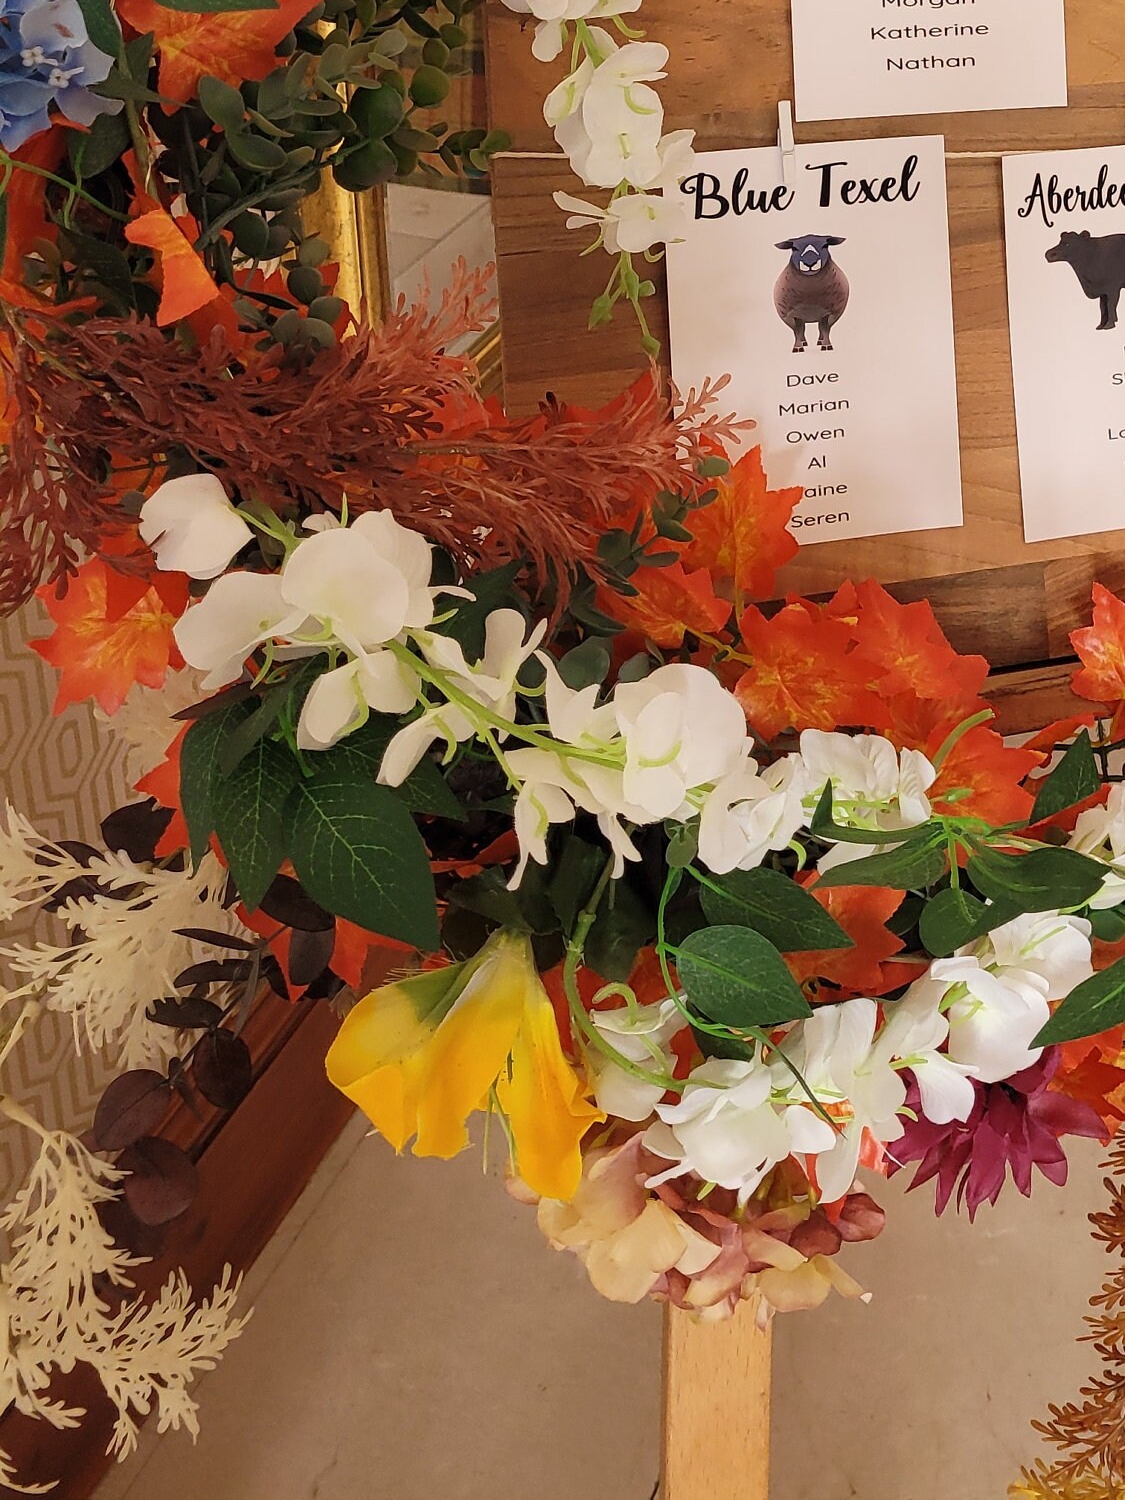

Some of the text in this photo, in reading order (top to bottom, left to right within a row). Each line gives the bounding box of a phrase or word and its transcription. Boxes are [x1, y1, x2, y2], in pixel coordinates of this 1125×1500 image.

[870, 23, 989, 40] Katherine
[886, 55, 976, 71] Nathan
[678, 154, 921, 220] Blue Texel
[786, 373, 839, 388] Dave
[779, 399, 850, 417] Marian
[786, 428, 845, 444] Owen
[807, 455, 827, 470] Al
[804, 484, 848, 498] aine
[791, 511, 850, 528] Seren
